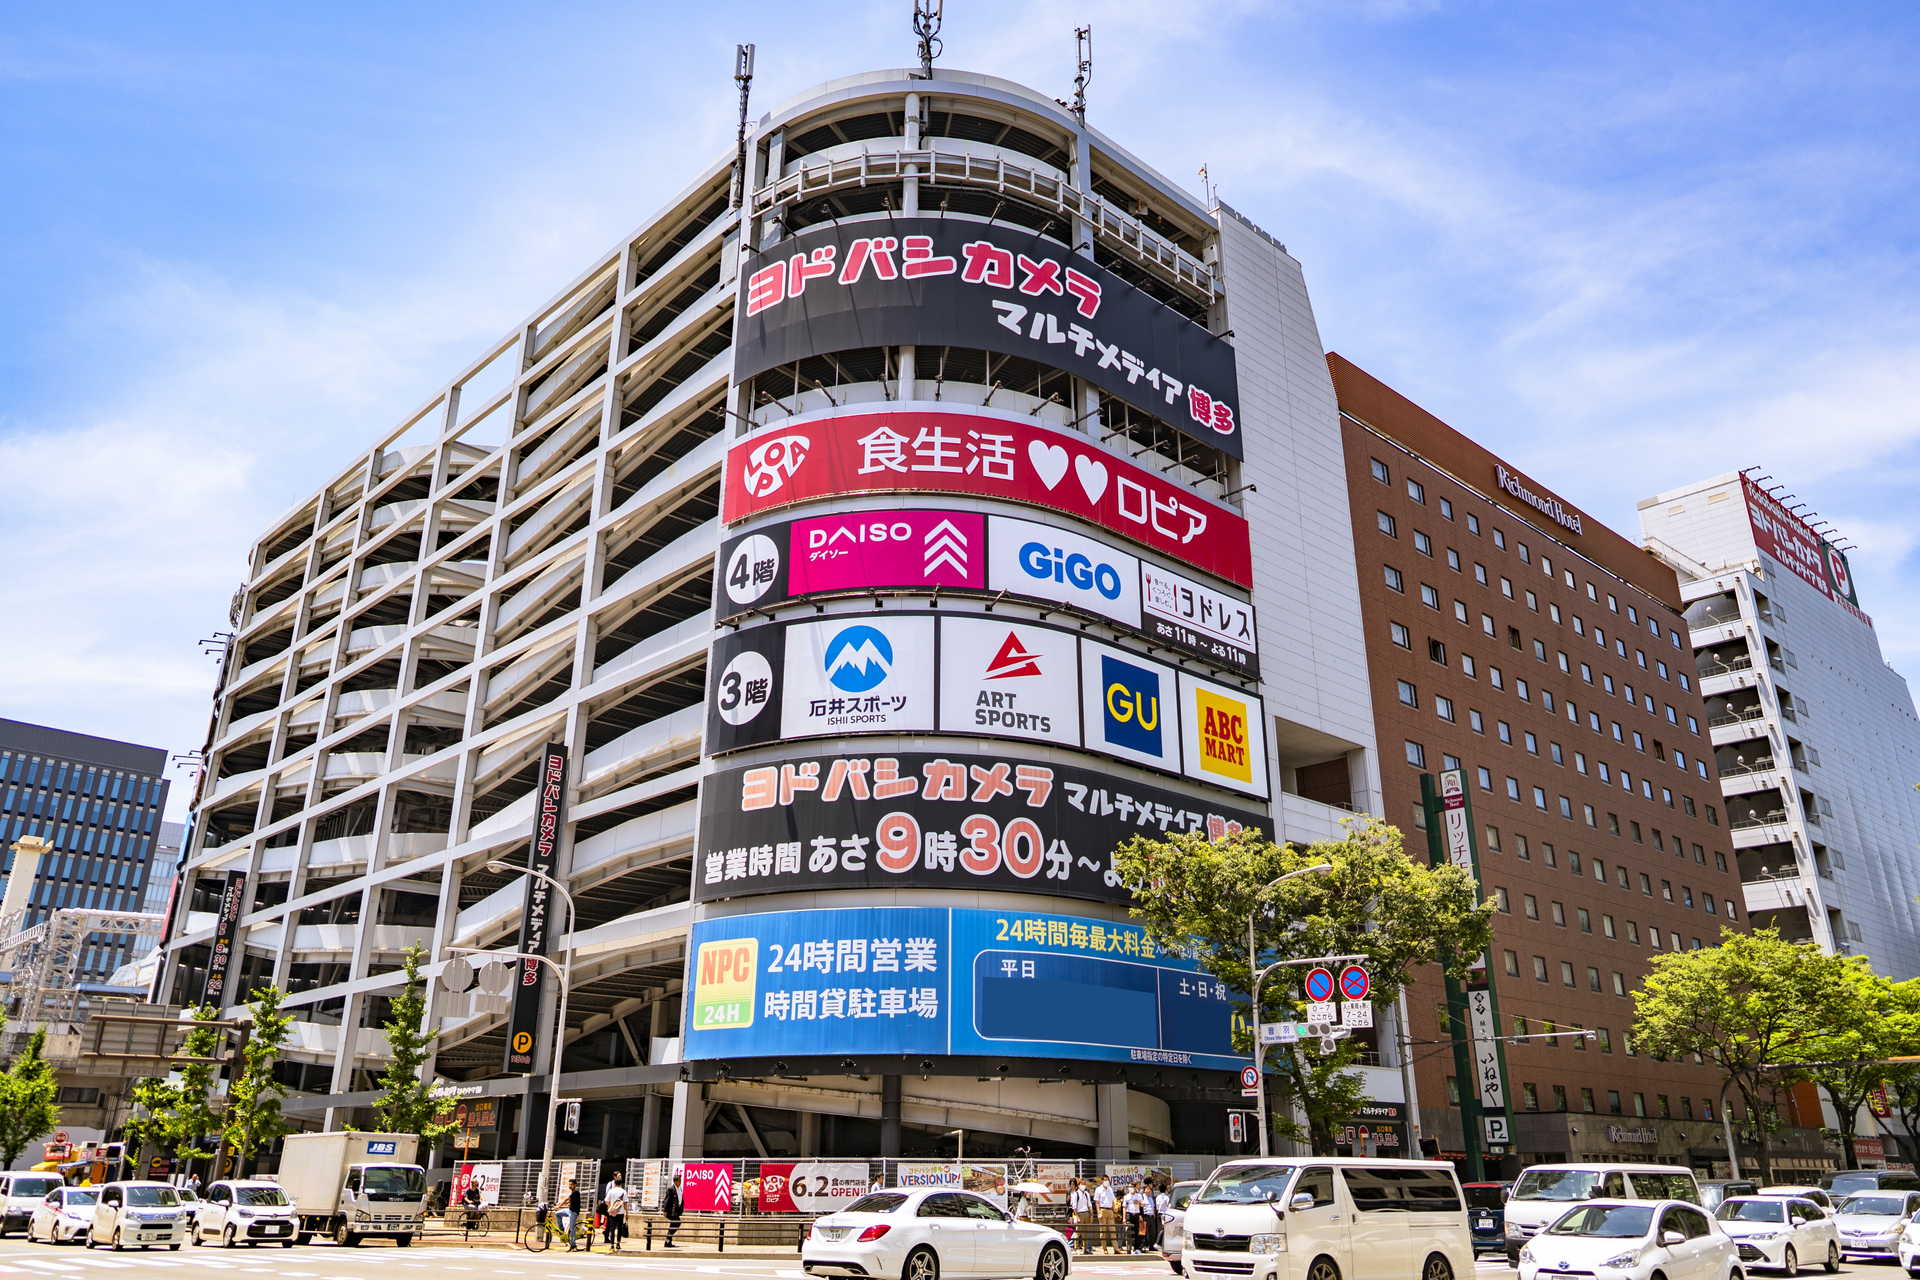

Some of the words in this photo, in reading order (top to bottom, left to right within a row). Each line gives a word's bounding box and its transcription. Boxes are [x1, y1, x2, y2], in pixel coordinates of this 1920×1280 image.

[747, 235, 1102, 320] ヨドバシカメラ
[992, 300, 1183, 405] マルチメディア
[1187, 383, 1235, 435] 博多
[857, 426, 1016, 481] 食生活
[1117, 475, 1207, 544] ロピア
[1495, 463, 1555, 519] Richmond
[1551, 499, 1583, 536] Hotel
[809, 522, 912, 548] DAISO
[730, 553, 775, 590] 4階
[809, 549, 848, 562] ダイソー
[1019, 541, 1121, 600] GiGO
[1181, 587, 1250, 640] ヨドレス
[721, 671, 768, 711] 3階
[809, 696, 907, 717] 石井スポーツ
[977, 690, 1016, 709] ART
[1107, 682, 1158, 731] GU
[827, 716, 848, 725] ISHII
[850, 714, 887, 725] SPORTS
[975, 708, 1051, 733] SPORTS
[1205, 706, 1243, 742] ABC
[1206, 737, 1244, 766] MART
[538, 755, 563, 857] ヨドバシカメラ
[742, 757, 1054, 811] ヨドバシカメラ
[1064, 780, 1203, 832] マルチメディア
[705, 842, 801, 884] 営業時間
[527, 864, 550, 953] マルチメディア
[768, 938, 937, 974] 24時間営業
[995, 918, 1156, 959] 24時間毎最大料金
[701, 948, 750, 985] NPC
[1001, 959, 1035, 979] 平日
[704, 1006, 740, 1024] 24H
[764, 988, 938, 1021] 時間貸駐車場
[518, 1034, 529, 1050] P
[370, 1143, 394, 1151] JBS
[1490, 1119, 1503, 1139] P
[686, 1169, 714, 1180] DAISO
[792, 1176, 829, 1197] 6.2
[901, 1173, 943, 1186] VERSION
[944, 1172, 961, 1185] UP!
